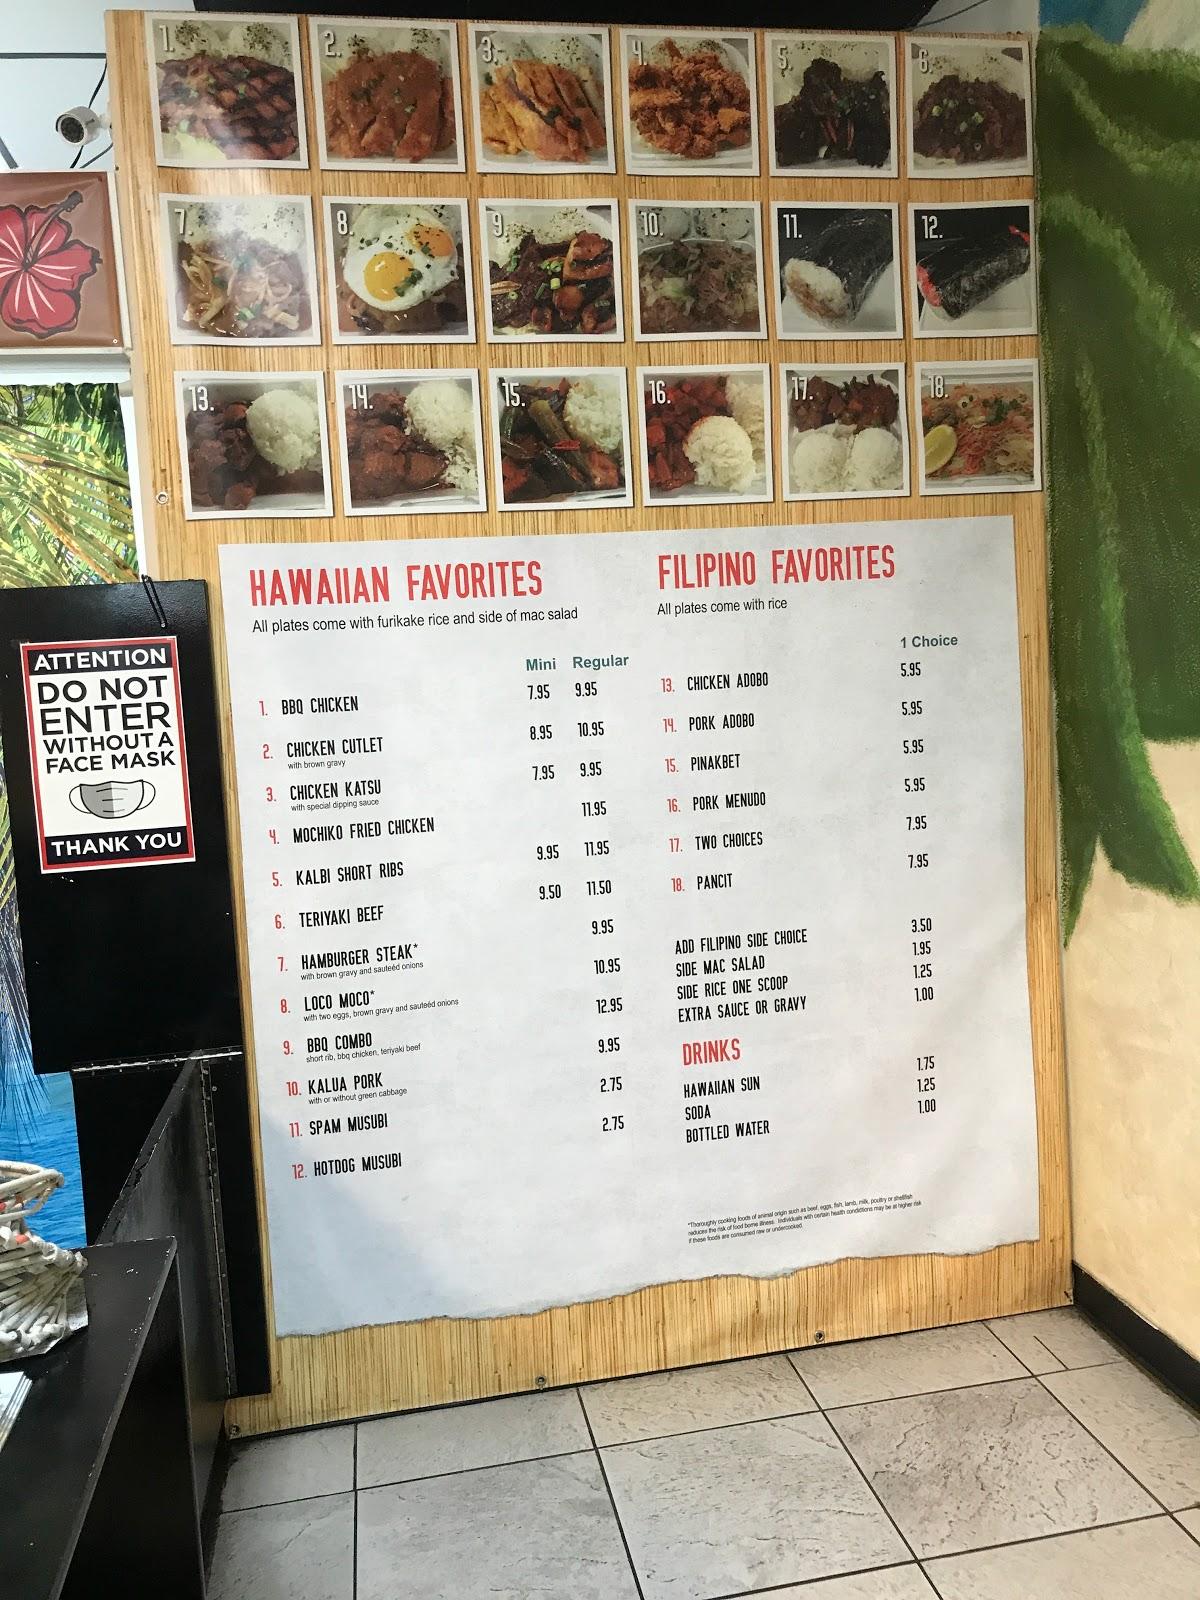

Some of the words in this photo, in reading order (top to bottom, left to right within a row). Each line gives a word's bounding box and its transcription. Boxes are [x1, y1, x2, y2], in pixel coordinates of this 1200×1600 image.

[159, 25, 174, 52] 1.
[325, 31, 342, 58] 2.
[481, 36, 499, 64] 3.
[632, 40, 648, 66] 4.
[778, 45, 793, 71] 5.
[918, 48, 933, 74] 6.
[174, 208, 194, 237] 7.
[336, 210, 354, 236] 8.
[491, 213, 509, 237] 9.
[642, 211, 664, 237] 10.
[783, 213, 803, 239] 11.
[921, 215, 944, 240] 12.
[188, 385, 215, 411] 13.
[348, 384, 374, 410] 14.
[502, 382, 526, 407] 15.
[648, 380, 671, 405] 16.
[791, 376, 814, 401] 17.
[928, 375, 949, 399] 18.
[658, 551, 756, 590] FILIPINO
[772, 544, 895, 584] FAVORITES
[249, 566, 390, 607] HAWAIIAN
[406, 560, 542, 601] FAVORITES
[657, 602, 671, 615] All
[674, 601, 708, 618] plates
[710, 601, 740, 613] come
[743, 598, 765, 611] with
[768, 597, 788, 610] rice
[252, 619, 268, 633] All
[272, 618, 310, 635] plates
[312, 619, 346, 631] come
[349, 616, 374, 629] with
[377, 614, 425, 628] furikake
[428, 615, 450, 626] rice
[453, 611, 475, 625] and
[478, 610, 503, 624] side
[505, 609, 517, 623] of
[520, 610, 545, 622] mac
[547, 606, 578, 621] salad
[900, 636, 906, 649] 1
[911, 634, 958, 648] Choice
[34, 648, 167, 672] ATTENTION
[526, 657, 556, 671] Mini
[572, 654, 629, 671] Regular
[900, 661, 921, 677] 5.95
[37, 680, 87, 705] DO
[100, 675, 168, 701] NOT
[527, 683, 550, 700] 7.95
[574, 681, 598, 697] 9.95
[661, 678, 675, 693] 13.
[687, 673, 730, 691] CHICKEN
[736, 671, 769, 688] ADOBO
[259, 700, 268, 716] 1.
[281, 698, 304, 715] BBQ
[310, 695, 359, 713] CHICKEN
[901, 700, 923, 716] 5.95
[40, 701, 172, 736] ENTER
[662, 718, 677, 733] 14.
[689, 715, 716, 732] PORK
[722, 712, 755, 729] ADOBO
[529, 724, 553, 741] 8.95
[577, 721, 605, 738] 10.95
[43, 732, 154, 754] WITHOUT
[158, 732, 175, 747] A
[262, 743, 273, 759] 2.
[286, 739, 336, 758] CHICKEN
[341, 736, 383, 754] CUTLET
[903, 738, 924, 754] 5.95
[46, 755, 103, 774] FACE
[111, 750, 176, 770] MASK
[287, 761, 303, 770] with
[302, 761, 326, 769] brown
[325, 760, 346, 769] gravy
[532, 764, 555, 781] 7.95
[579, 761, 602, 777] 9.95
[665, 758, 679, 773] 15.
[690, 753, 741, 772] PINAKBET
[266, 786, 277, 802] 3.
[290, 782, 339, 801] CHICKEN
[344, 779, 381, 797] KATSU
[904, 777, 925, 793] 5.95
[581, 800, 607, 817] 11.95
[667, 798, 681, 813] 16.
[692, 794, 720, 812] PORK
[725, 791, 766, 809] MENUDO
[269, 829, 280, 845] 4.
[292, 824, 343, 844] MOCHIKO
[349, 821, 382, 839] FRIED
[387, 817, 435, 836] CHICKEN
[906, 815, 927, 831] 7.95
[51, 836, 130, 857] THANK
[135, 831, 182, 850] YOU
[536, 844, 559, 861] 9.95
[584, 840, 610, 857] 11.95
[669, 837, 683, 853] 17.
[694, 834, 717, 851] TWO
[722, 831, 763, 848] CHOICES
[907, 853, 929, 869] 7.95
[272, 872, 283, 887] 5.
[296, 868, 331, 886] KALBI
[337, 864, 372, 883] SHORT
[379, 861, 404, 879] RIBS
[671, 877, 685, 892] 18.
[697, 873, 733, 890] PANCIT
[539, 884, 562, 900] 9.50
[586, 879, 612, 896] 11.50
[274, 914, 285, 929] 6.
[298, 908, 351, 928] TERIYAKI
[356, 904, 384, 923] BEEF
[591, 918, 614, 935] 9.95
[911, 917, 932, 933] 3.50
[675, 938, 695, 955] ADD
[700, 934, 742, 953] FILIPINO
[747, 932, 769, 948] SIDE
[774, 928, 808, 945] CHOICE
[912, 940, 932, 956] 1.95
[277, 956, 288, 972] 7.
[301, 948, 370, 970] HAMBURGER
[593, 957, 621, 975] 10.95
[675, 961, 698, 978] SIDE
[703, 958, 726, 975] MAC
[731, 954, 765, 972] SALAD
[913, 963, 933, 979] 1.25
[677, 983, 699, 1000] SIDE
[704, 980, 727, 998] RICE
[732, 978, 753, 995] ONE
[757, 975, 788, 992] SCOOP
[914, 986, 934, 1002] 1.00
[280, 998, 291, 1014] 8.
[304, 994, 333, 1012] LOCO
[595, 997, 623, 1014] 12.95
[678, 1005, 712, 1023] EXTRA
[717, 1001, 750, 1019] SAUCE
[755, 999, 768, 1015] OR
[774, 995, 807, 1013] GRAVY
[283, 1040, 294, 1056] 9.
[307, 1036, 329, 1054] BBQ
[334, 1032, 373, 1051] COMBO
[598, 1036, 620, 1054] 9.95
[682, 1038, 741, 1066] DRINKS
[916, 1055, 935, 1071] 1.75
[286, 1081, 302, 1097] 10.
[308, 1076, 348, 1095] KALUA
[353, 1072, 383, 1091] PORK
[600, 1076, 623, 1093] 2.75
[683, 1078, 735, 1099] HAWAIIAN
[740, 1075, 760, 1092] SUN
[917, 1077, 936, 1093] 1.25
[308, 1093, 323, 1105] with
[323, 1093, 332, 1104] or
[331, 1092, 357, 1103] without
[357, 1089, 378, 1104] green
[378, 1088, 408, 1098] cabbage
[917, 1098, 936, 1114] 1.00
[602, 1115, 625, 1132] 2.75
[684, 1104, 711, 1121] SODA
[289, 1122, 303, 1138] 11.
[309, 1117, 342, 1136] SPAM
[347, 1112, 388, 1132] MUSUBI
[686, 1124, 730, 1143] BOTTLED
[735, 1120, 770, 1138] WATER
[292, 1164, 308, 1180] 12.
[313, 1157, 356, 1177] HOTDOG
[361, 1152, 402, 1172] MUSUBI
